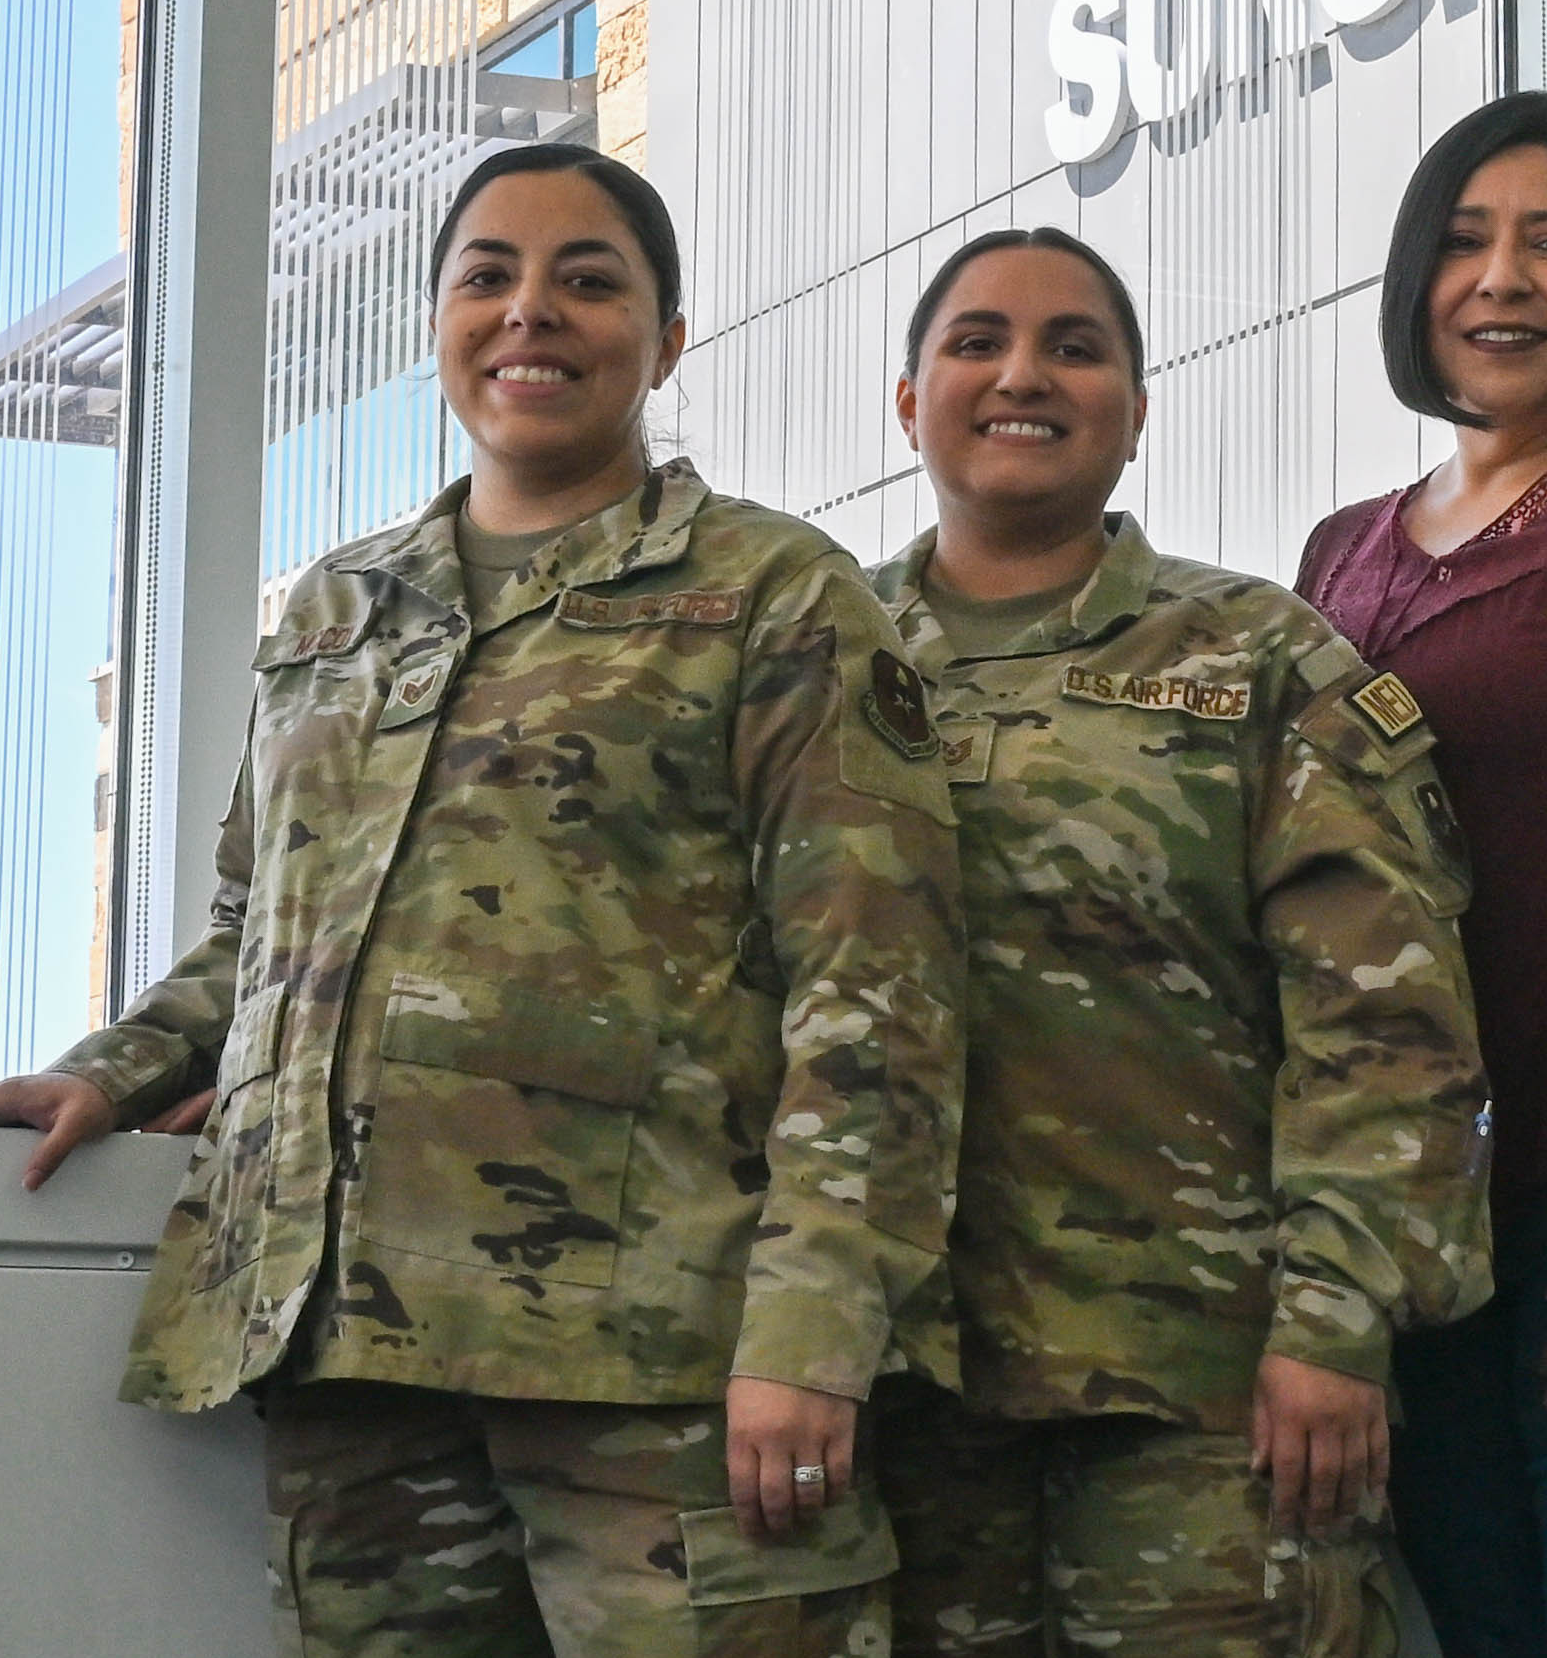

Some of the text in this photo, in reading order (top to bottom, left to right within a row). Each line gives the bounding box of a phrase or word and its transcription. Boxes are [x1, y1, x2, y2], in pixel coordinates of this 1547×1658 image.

[1120, 676, 1164, 706] AIR
[1167, 678, 1249, 717] FORCE
[1360, 678, 1418, 730] MED
